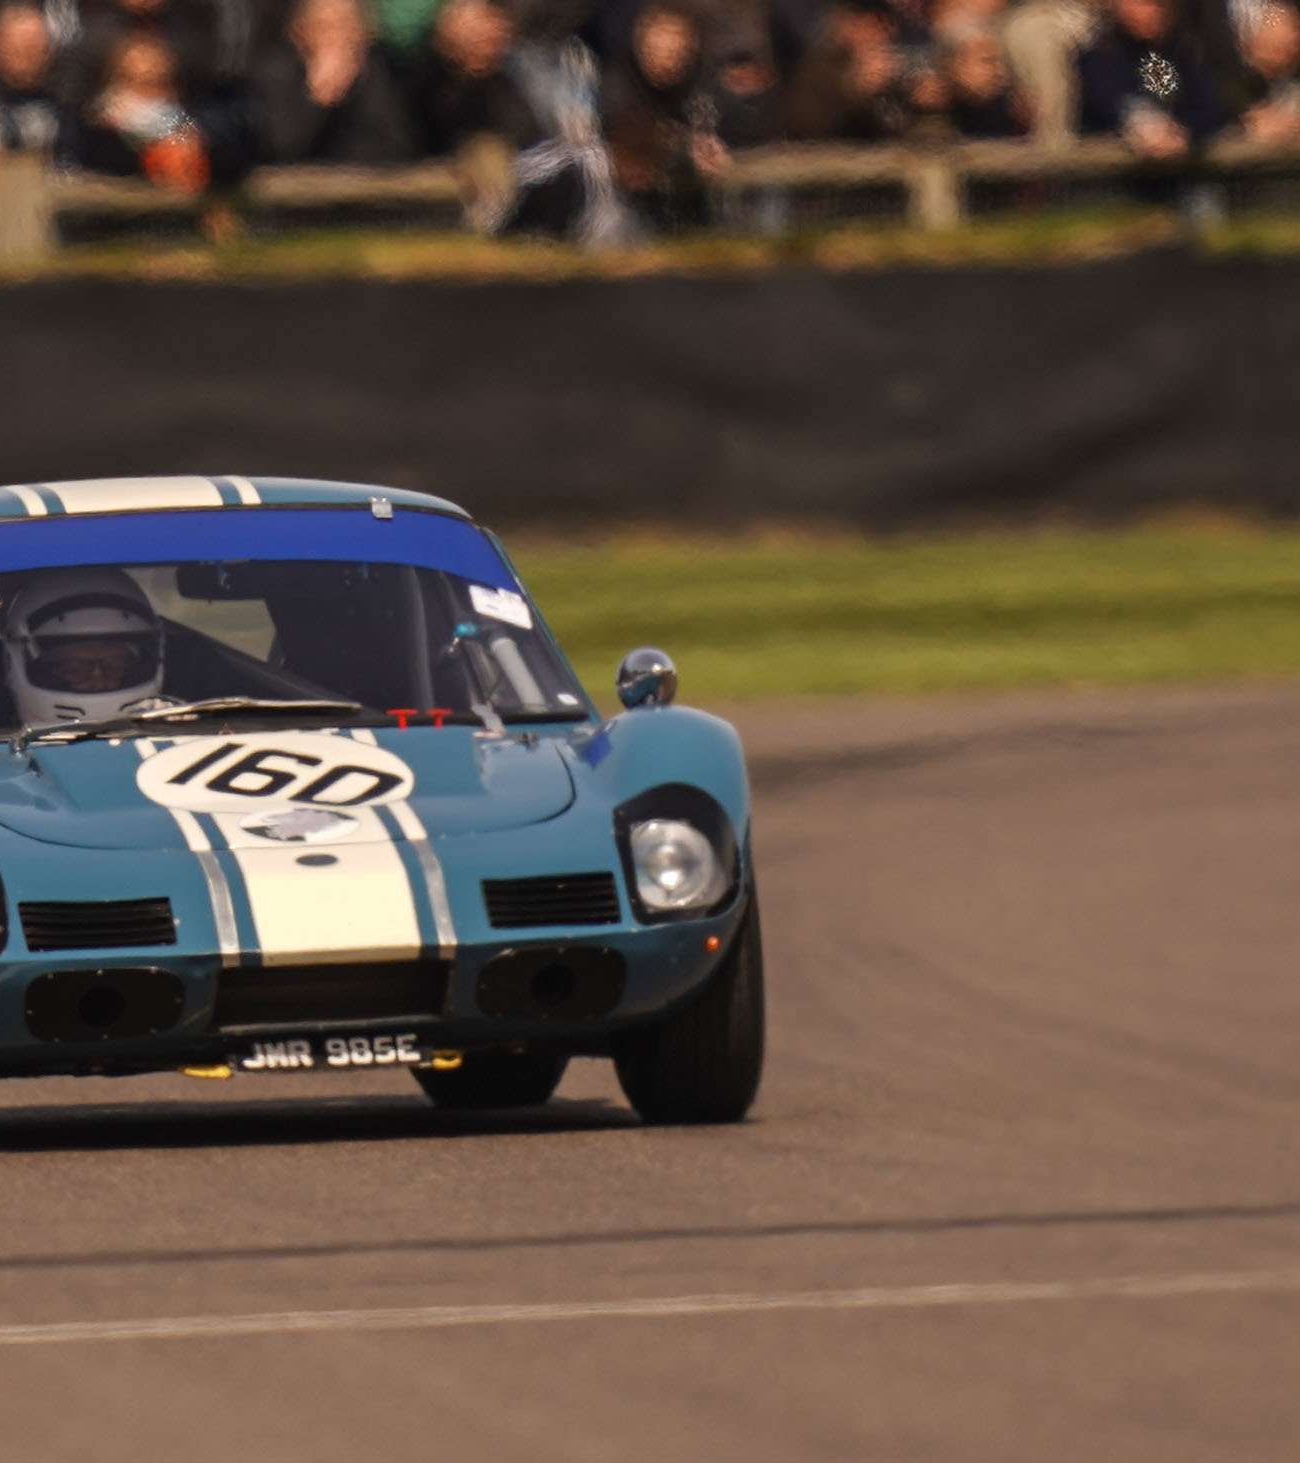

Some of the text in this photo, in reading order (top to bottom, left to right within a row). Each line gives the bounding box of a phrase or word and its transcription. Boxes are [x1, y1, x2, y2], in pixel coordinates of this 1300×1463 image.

[167, 742, 404, 806] 160
[242, 1033, 421, 1069] JMR 985E
